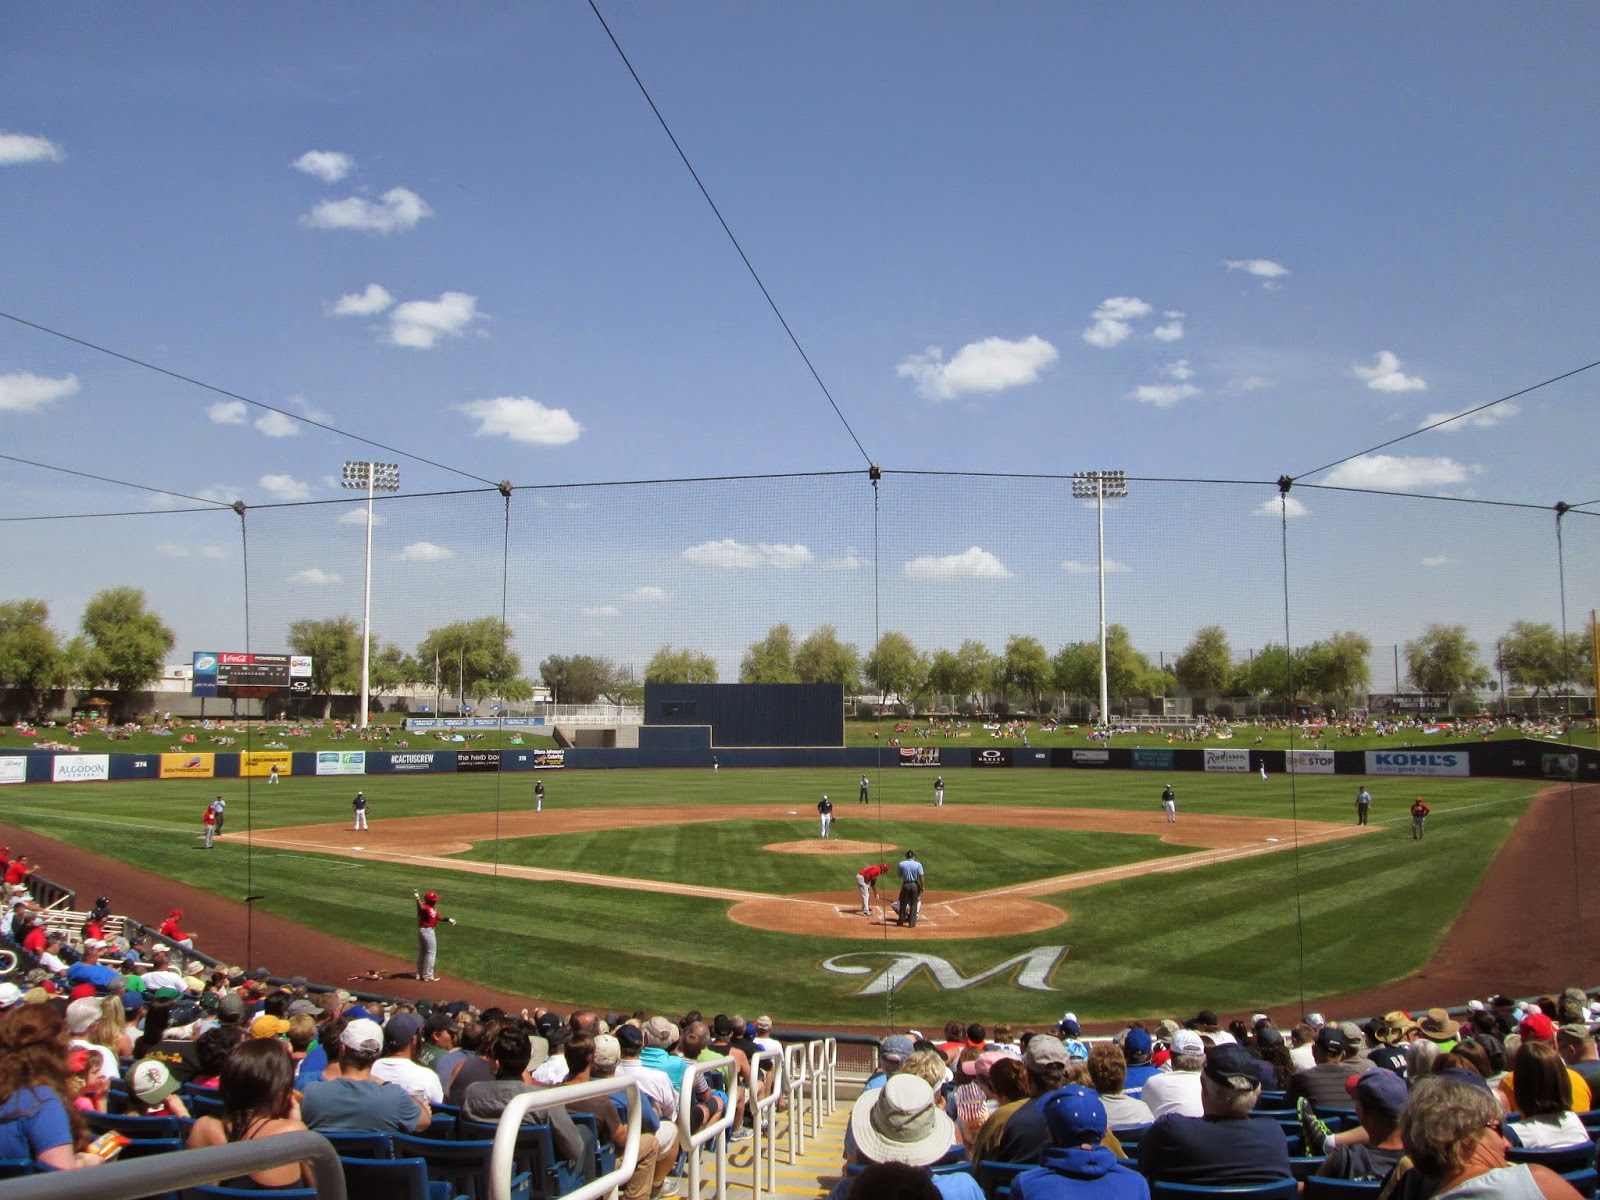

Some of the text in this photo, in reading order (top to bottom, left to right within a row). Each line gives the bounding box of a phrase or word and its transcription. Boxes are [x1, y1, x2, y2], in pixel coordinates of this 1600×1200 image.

[391, 754, 434, 763] #CACTUSCREW
[1207, 751, 1246, 765] Radisson
[1308, 758, 1333, 766] STOP
[1375, 754, 1457, 767] KOHL'S
[59, 765, 105, 774] ALGODON
